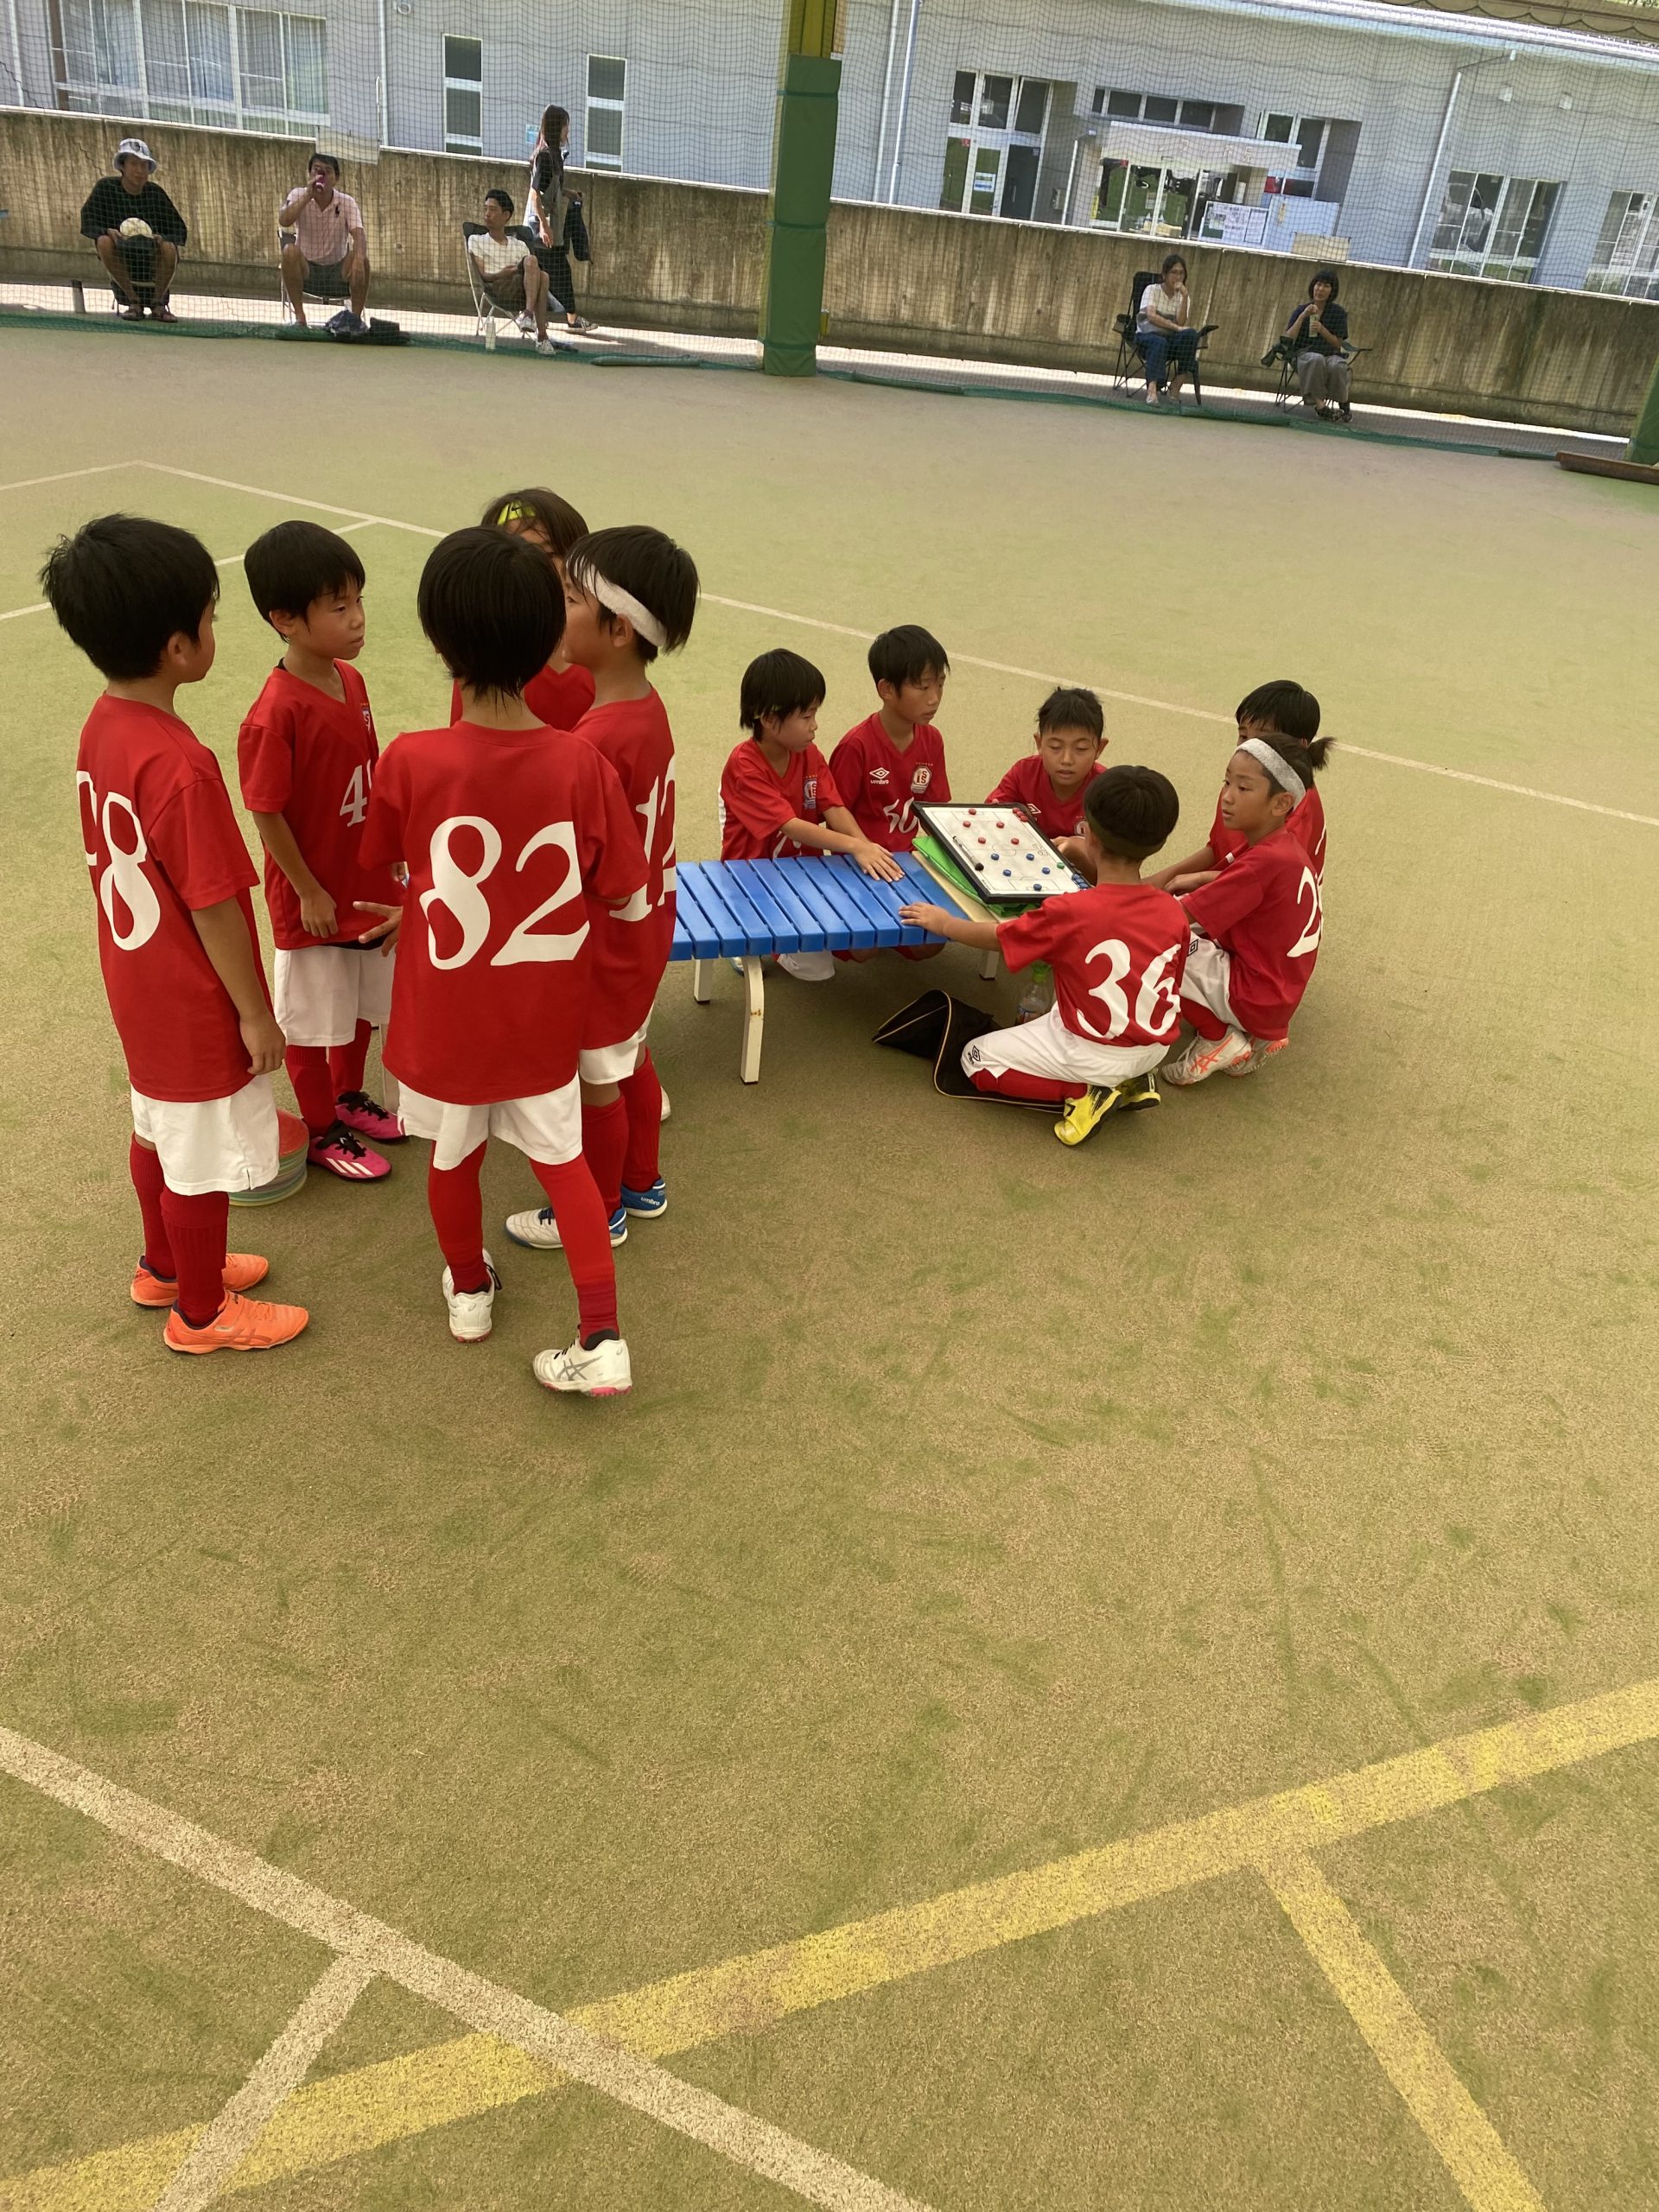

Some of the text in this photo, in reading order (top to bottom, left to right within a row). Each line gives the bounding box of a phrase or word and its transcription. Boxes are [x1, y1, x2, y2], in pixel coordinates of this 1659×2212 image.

[340, 758, 372, 828] 4
[419, 815, 591, 970] 82
[1076, 938, 1182, 1040] 36
